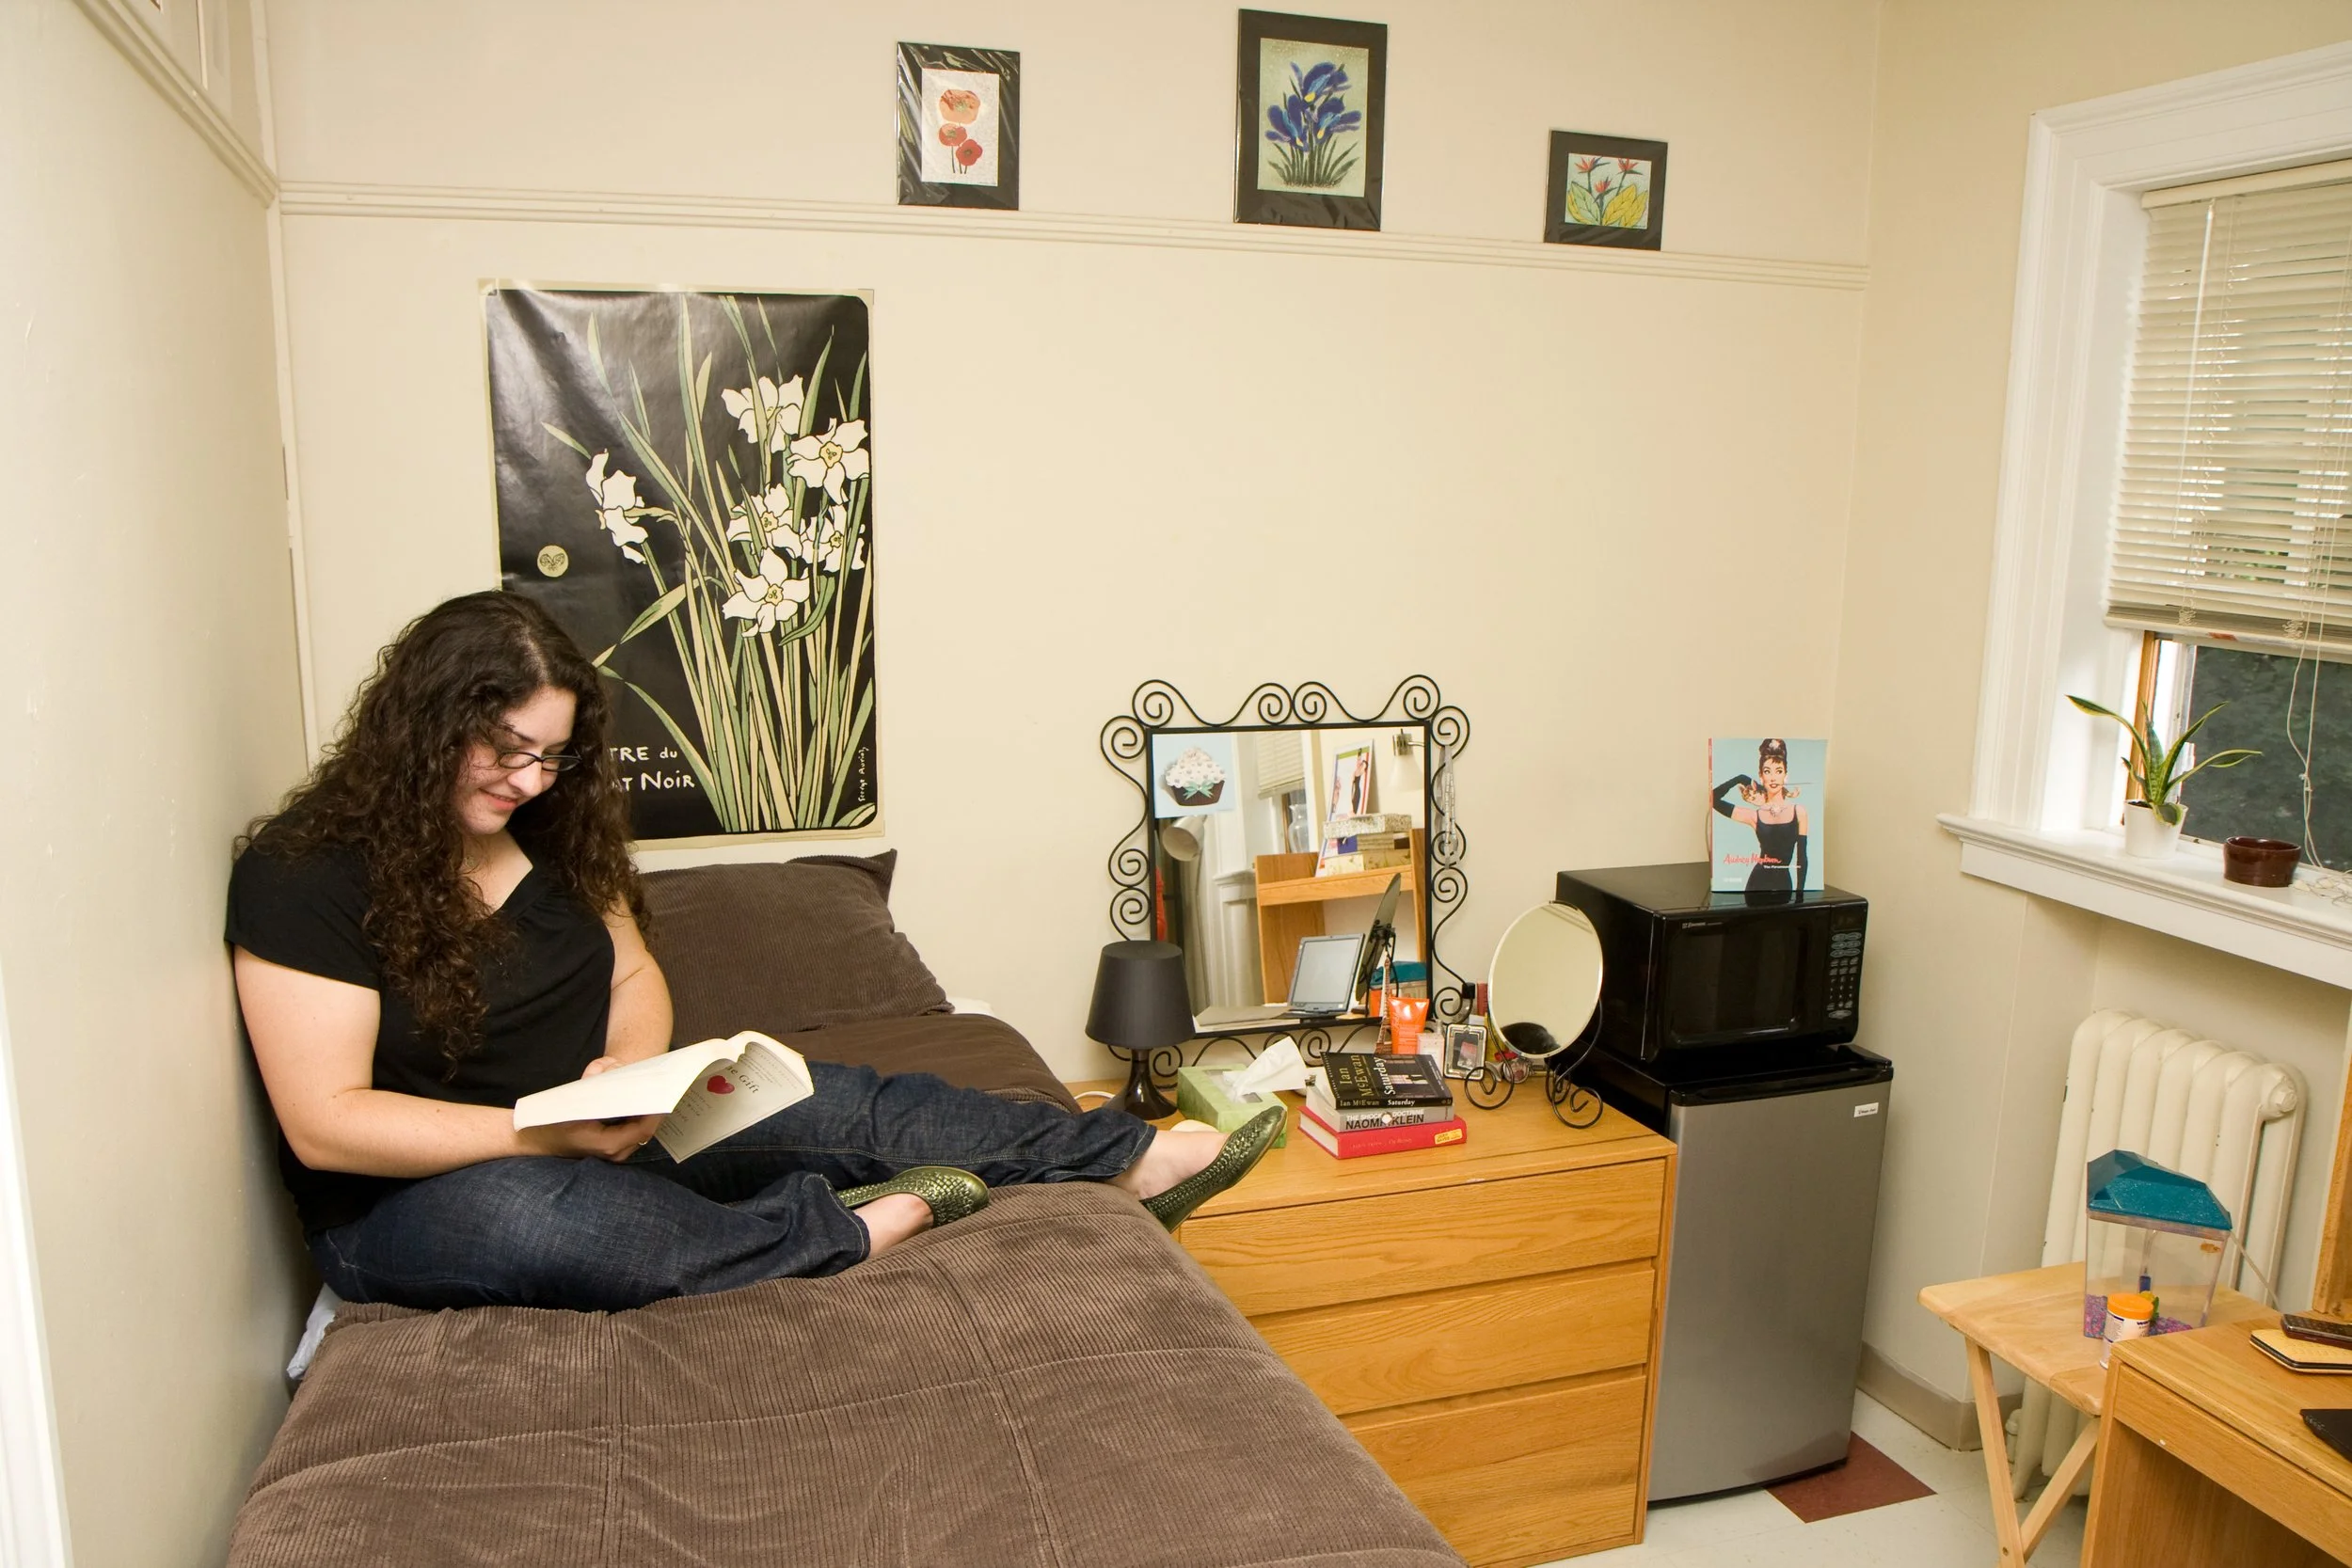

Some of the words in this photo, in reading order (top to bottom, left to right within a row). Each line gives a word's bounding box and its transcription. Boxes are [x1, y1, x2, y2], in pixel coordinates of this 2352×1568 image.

[660, 746, 678, 759] du
[1339, 1068, 1353, 1085] Ian
[1350, 1054, 1375, 1097] McEwan
[1374, 1056, 1396, 1096] Saturday
[739, 1074, 760, 1094] Gift
[1387, 1098, 1416, 1107] Saturday
[1392, 1108, 1424, 1117] DOCTRINE
[1392, 1114, 1424, 1125] KLEIN
